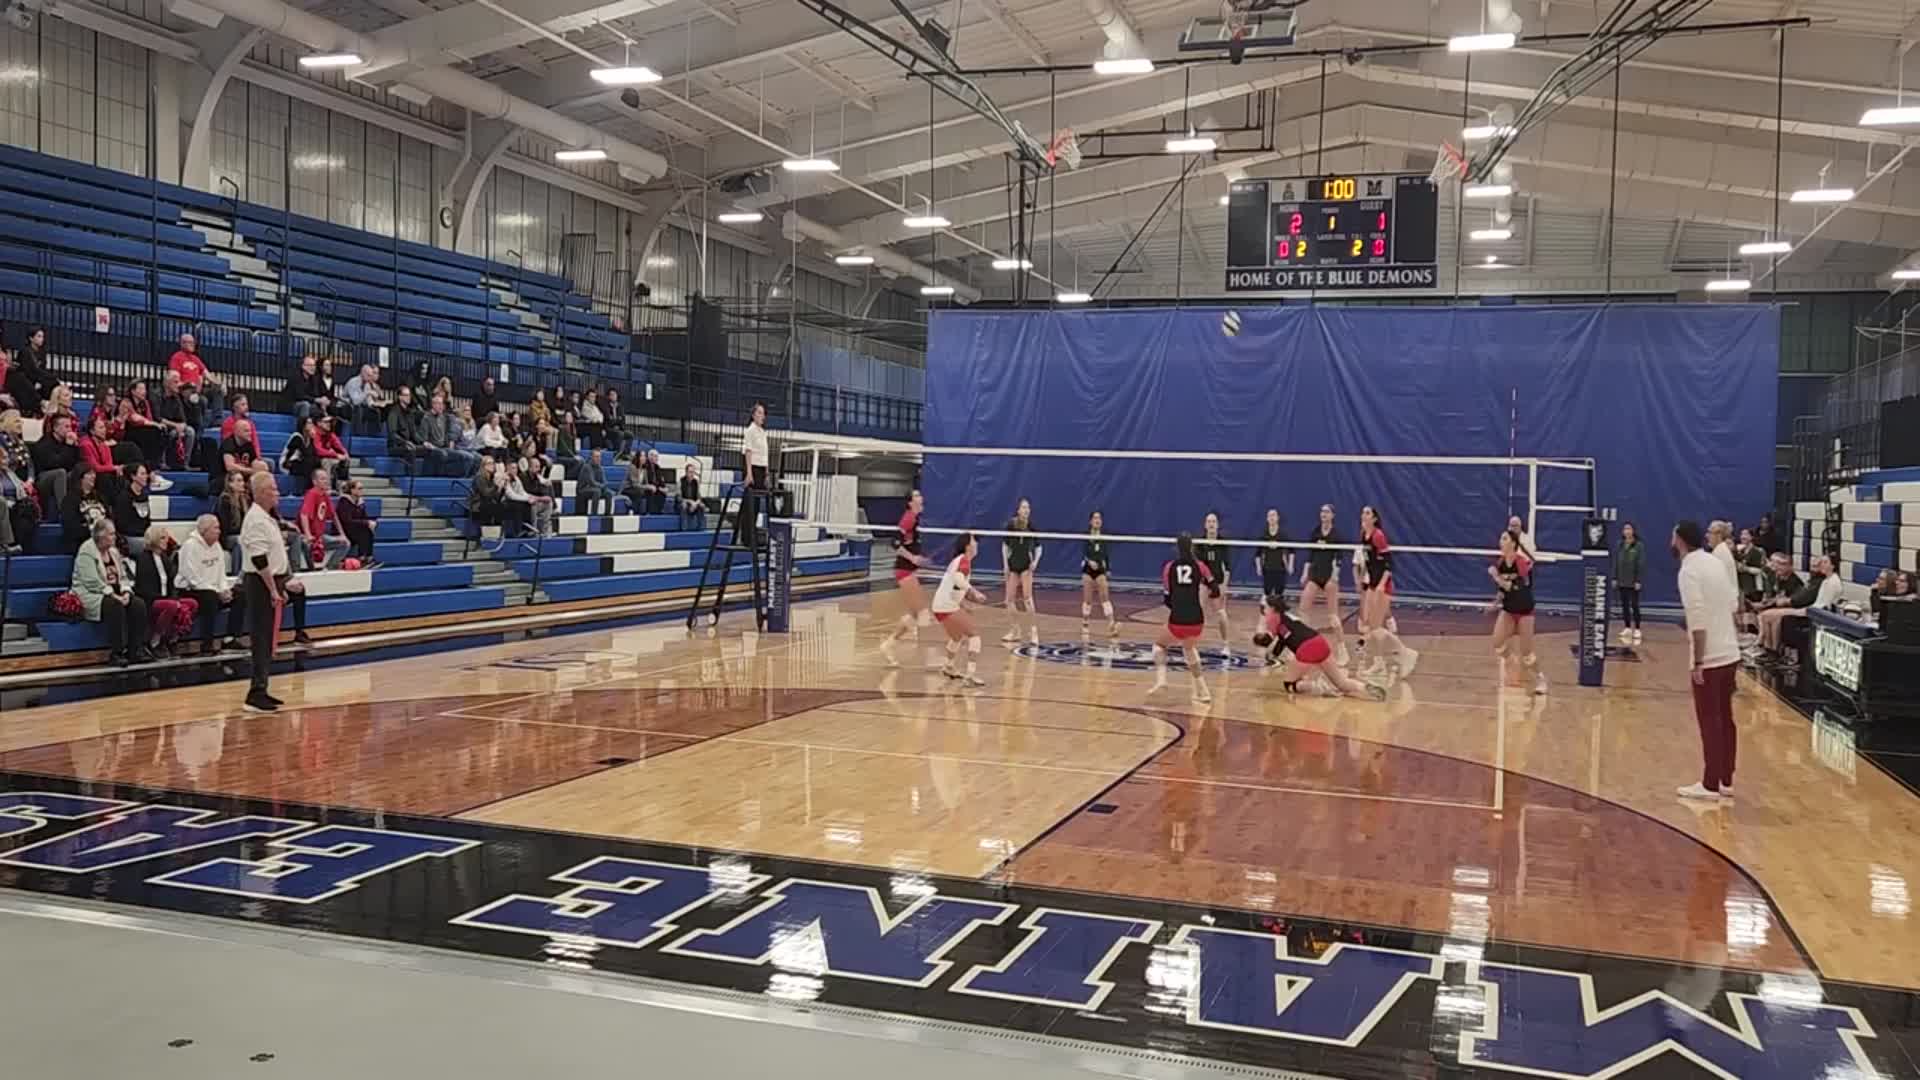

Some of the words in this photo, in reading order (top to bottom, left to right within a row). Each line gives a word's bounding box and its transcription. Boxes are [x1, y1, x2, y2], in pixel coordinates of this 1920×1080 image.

[1324, 179, 1354, 199] 1:00
[1289, 212, 1303, 235] 2
[1329, 215, 1336, 231] 1
[1296, 240, 1307, 257] 2
[1352, 240, 1363, 256] 2
[1230, 272, 1272, 287] HOME
[1275, 272, 1295, 286] OF
[1298, 271, 1324, 286] THE
[1328, 271, 1363, 285] BLUE
[1368, 269, 1433, 284] DEMONS
[1176, 565, 1192, 584] 12
[1595, 575, 1606, 619] MAINE
[1594, 623, 1604, 659] EAST
[447, 855, 1882, 1080] MAINE
